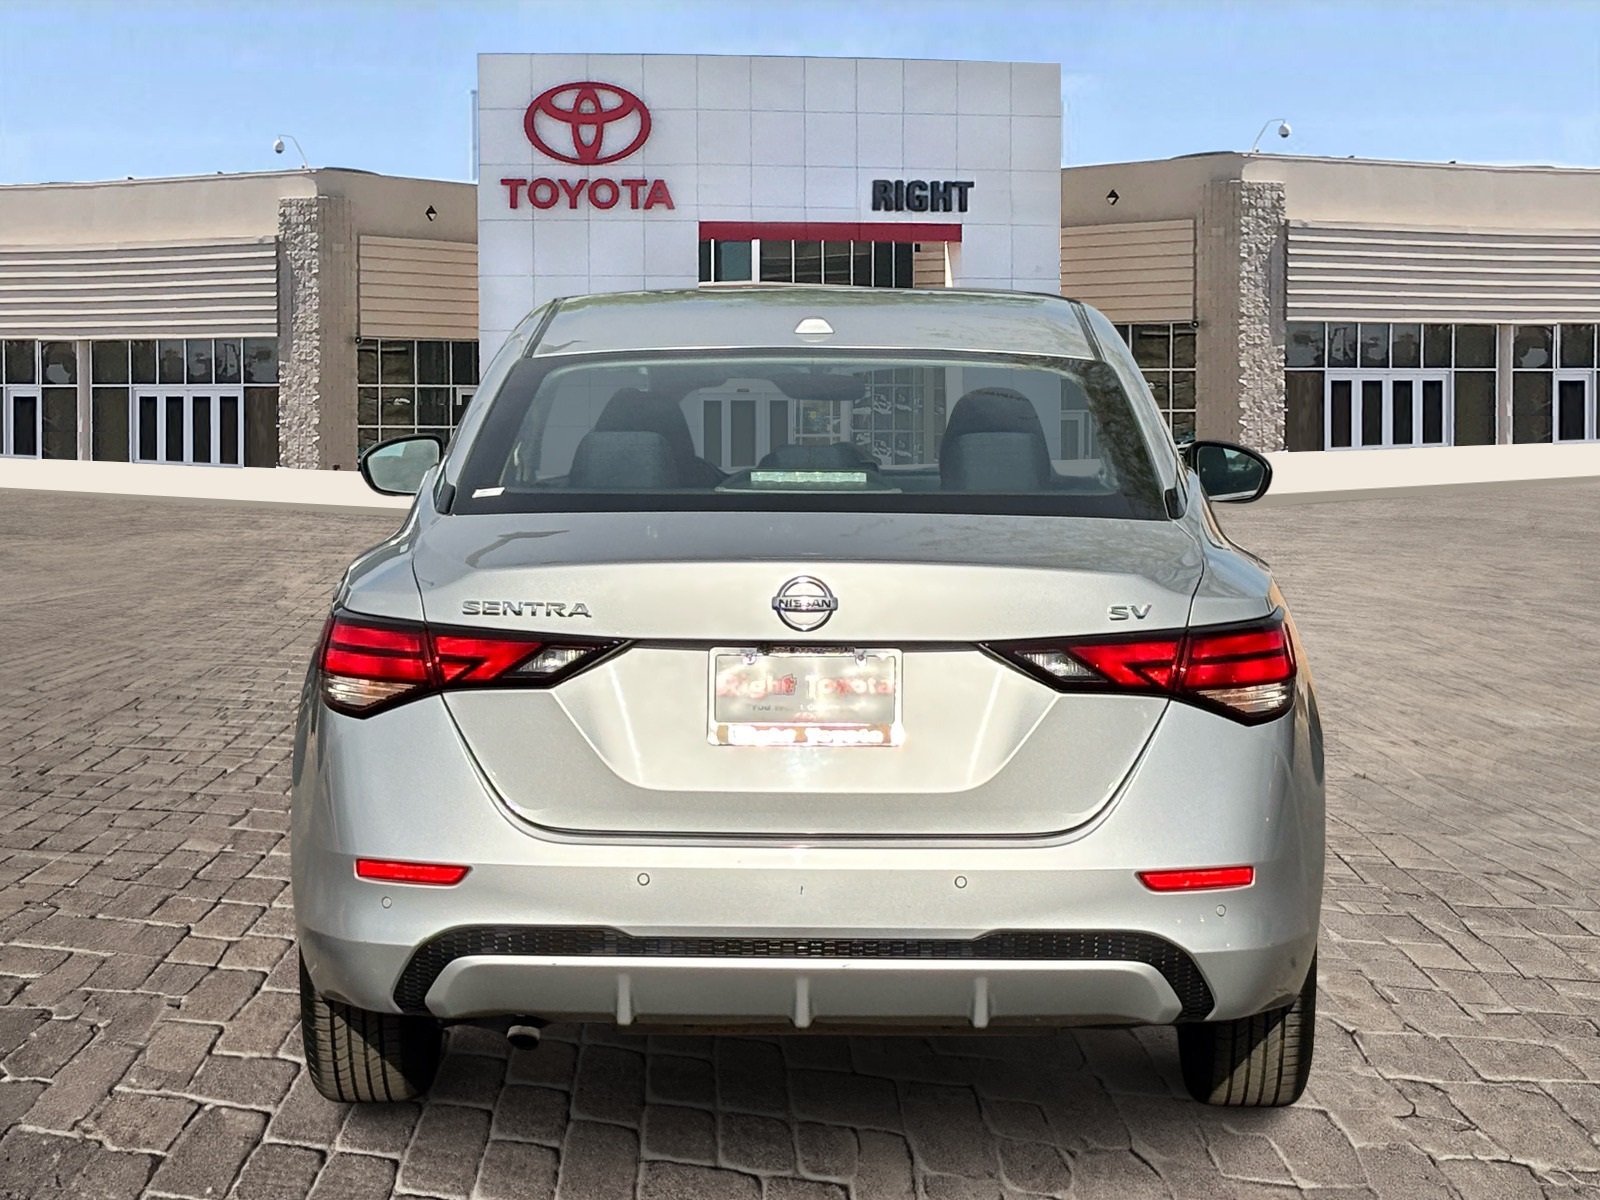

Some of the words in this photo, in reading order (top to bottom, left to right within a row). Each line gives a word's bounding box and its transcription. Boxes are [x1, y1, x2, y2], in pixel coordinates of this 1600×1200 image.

[500, 178, 676, 211] TOYOTA
[871, 179, 975, 213] RIGHT
[462, 600, 592, 619] SENTRA
[1109, 604, 1152, 621] SV
